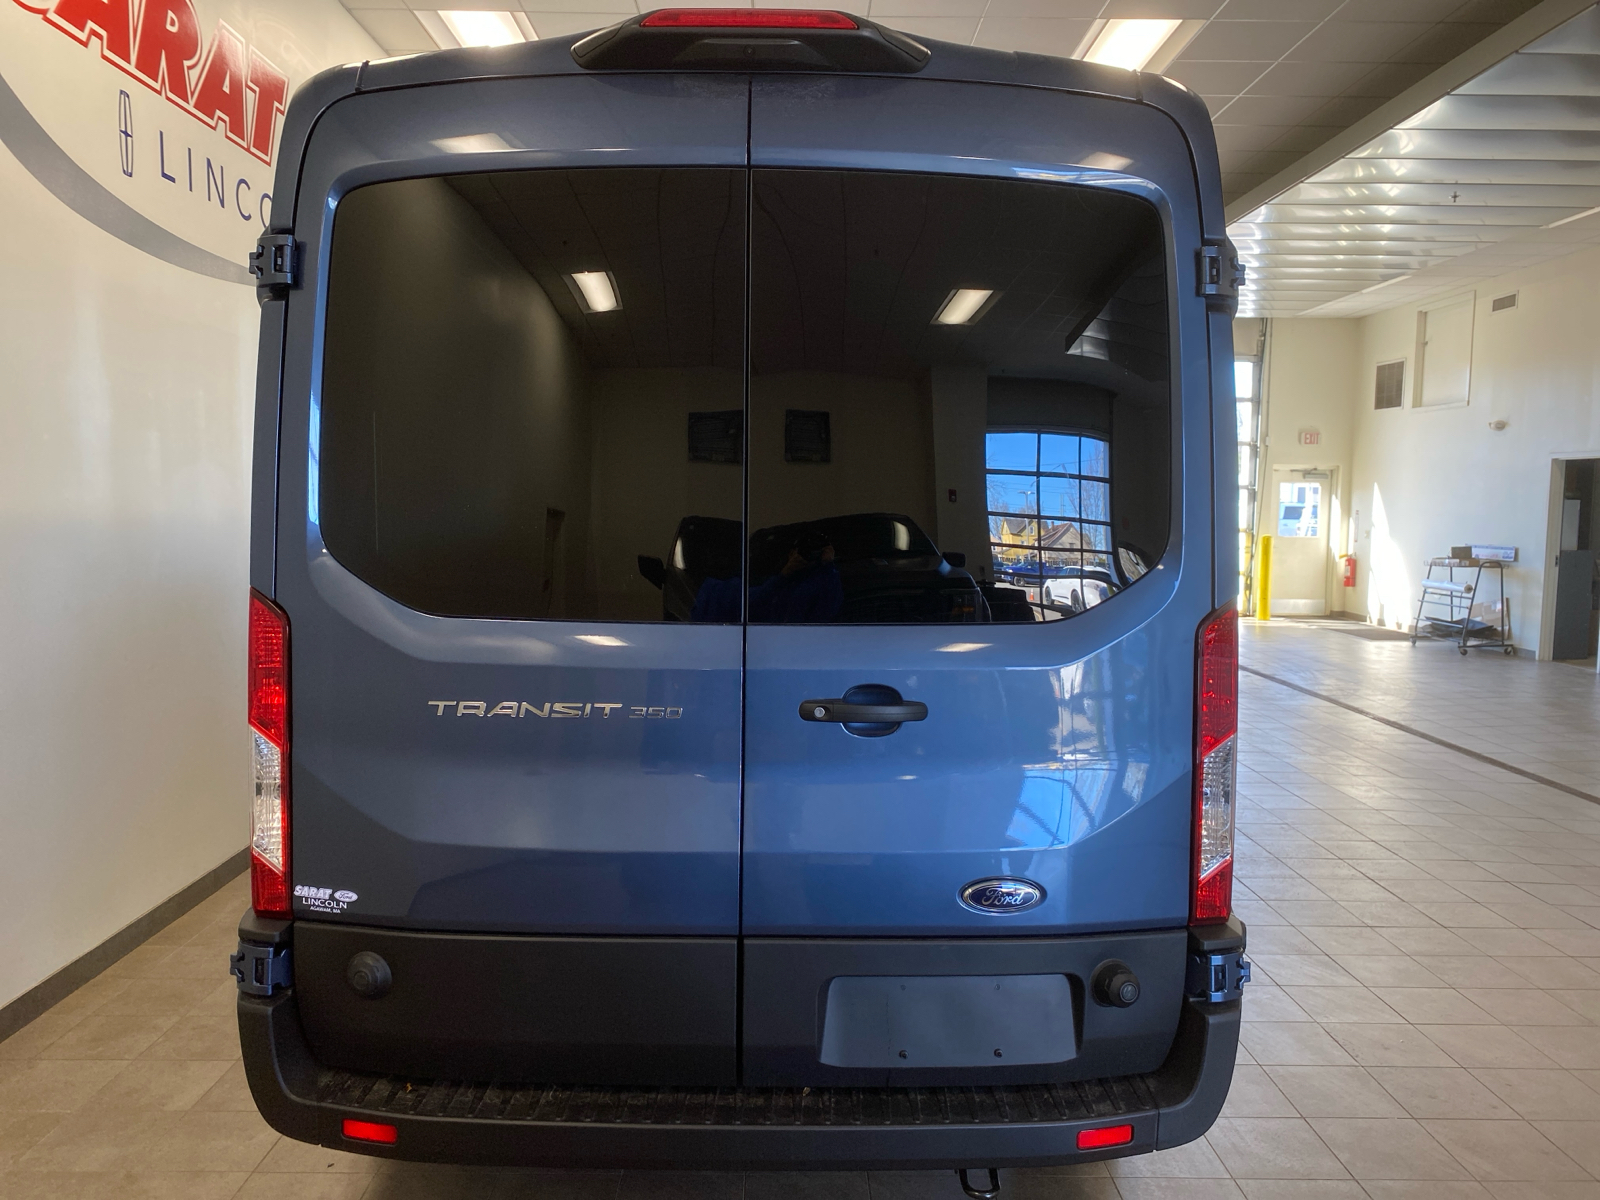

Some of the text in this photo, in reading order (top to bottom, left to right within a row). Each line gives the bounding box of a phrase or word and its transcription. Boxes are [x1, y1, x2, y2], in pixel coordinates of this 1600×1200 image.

[13, 0, 290, 167] ARAT
[1304, 432, 1320, 445] EXIT
[428, 700, 683, 718] TRANSIT 350
[293, 885, 354, 901] SARAT Ford
[980, 887, 1024, 906] Ford
[302, 897, 347, 909] LINCOLN
